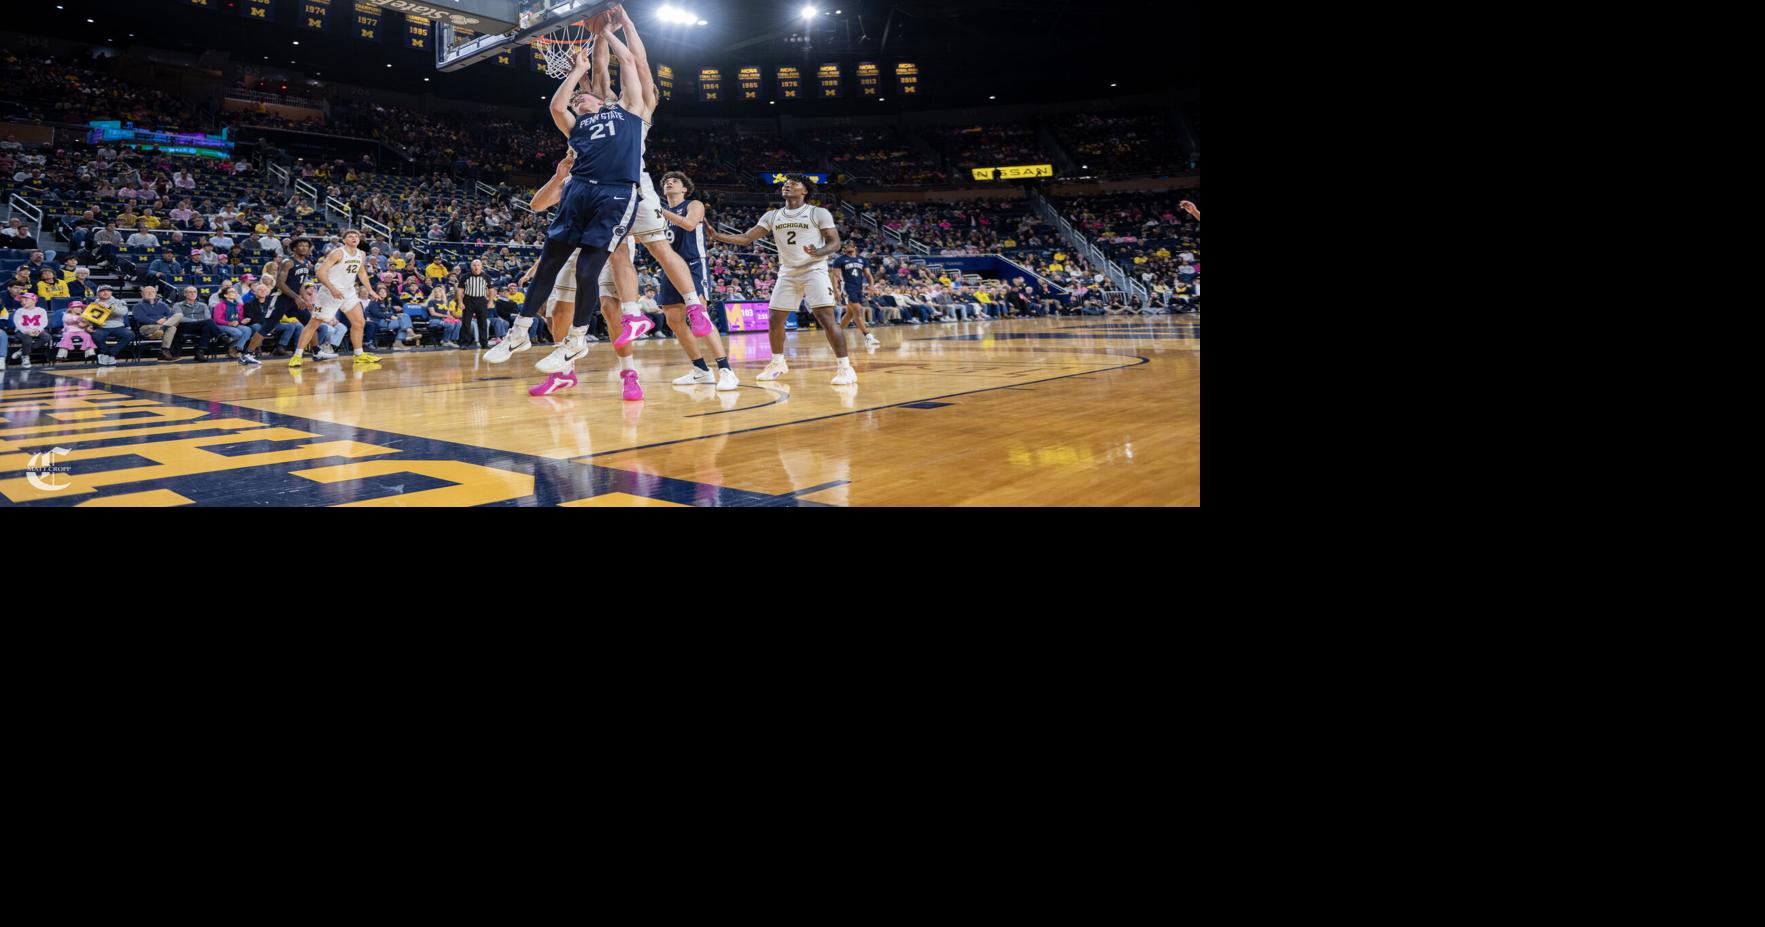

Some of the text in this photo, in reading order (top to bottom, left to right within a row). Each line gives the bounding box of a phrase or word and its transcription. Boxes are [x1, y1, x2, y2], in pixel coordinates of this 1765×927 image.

[305, 4, 326, 16] 1974
[358, 16, 377, 26] 1977
[580, 110, 624, 128] PENN STATE
[589, 120, 616, 140] 21
[976, 168, 1047, 178] NSSAN
[787, 231, 796, 245] 2
[346, 264, 358, 274] 42
[22, 315, 41, 326] M
